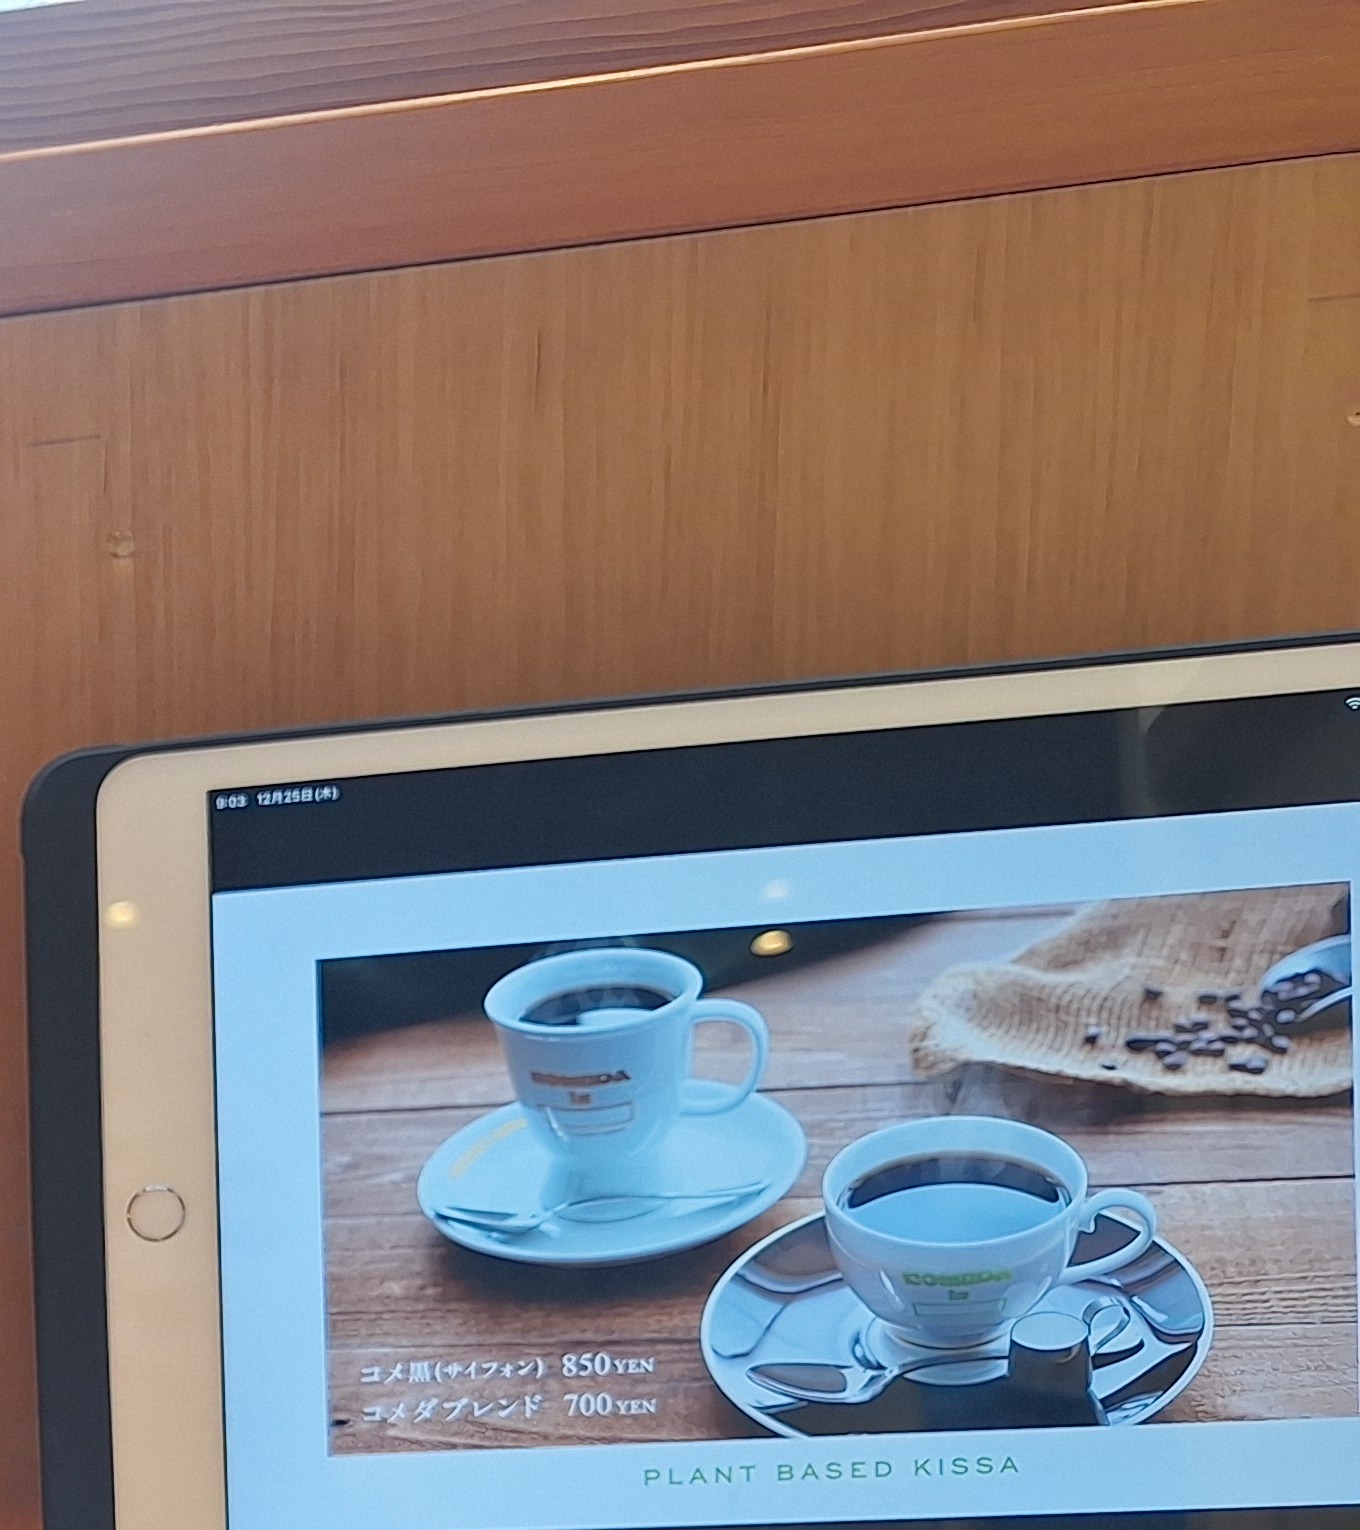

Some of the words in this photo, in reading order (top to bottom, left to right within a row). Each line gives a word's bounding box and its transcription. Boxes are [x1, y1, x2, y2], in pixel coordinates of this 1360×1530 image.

[361, 1394, 545, 1424] コメダブレンド
[643, 1464, 757, 1486] PLANT
[776, 1460, 893, 1482] BASED
[914, 1456, 1020, 1477] KISSA
